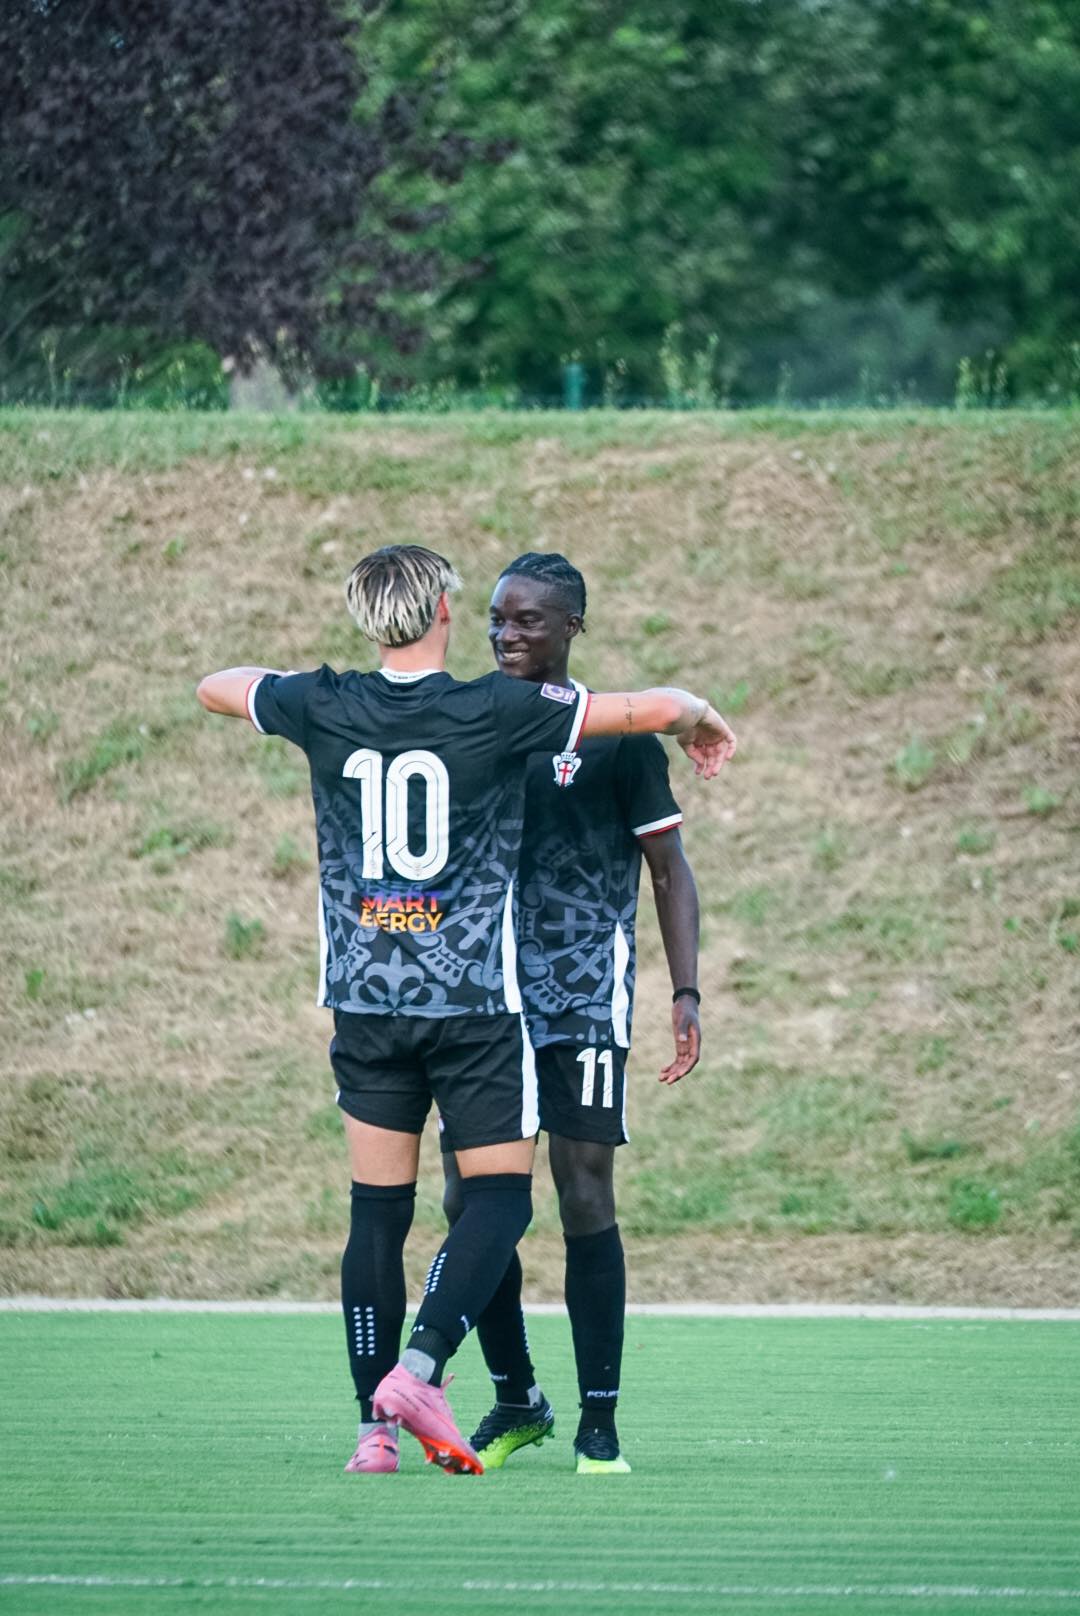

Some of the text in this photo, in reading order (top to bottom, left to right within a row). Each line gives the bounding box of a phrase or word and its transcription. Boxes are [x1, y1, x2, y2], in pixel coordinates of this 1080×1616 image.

[342, 748, 450, 881] 10
[360, 908, 443, 932] EERGY
[361, 891, 444, 913] MART
[576, 1047, 613, 1109] 11
